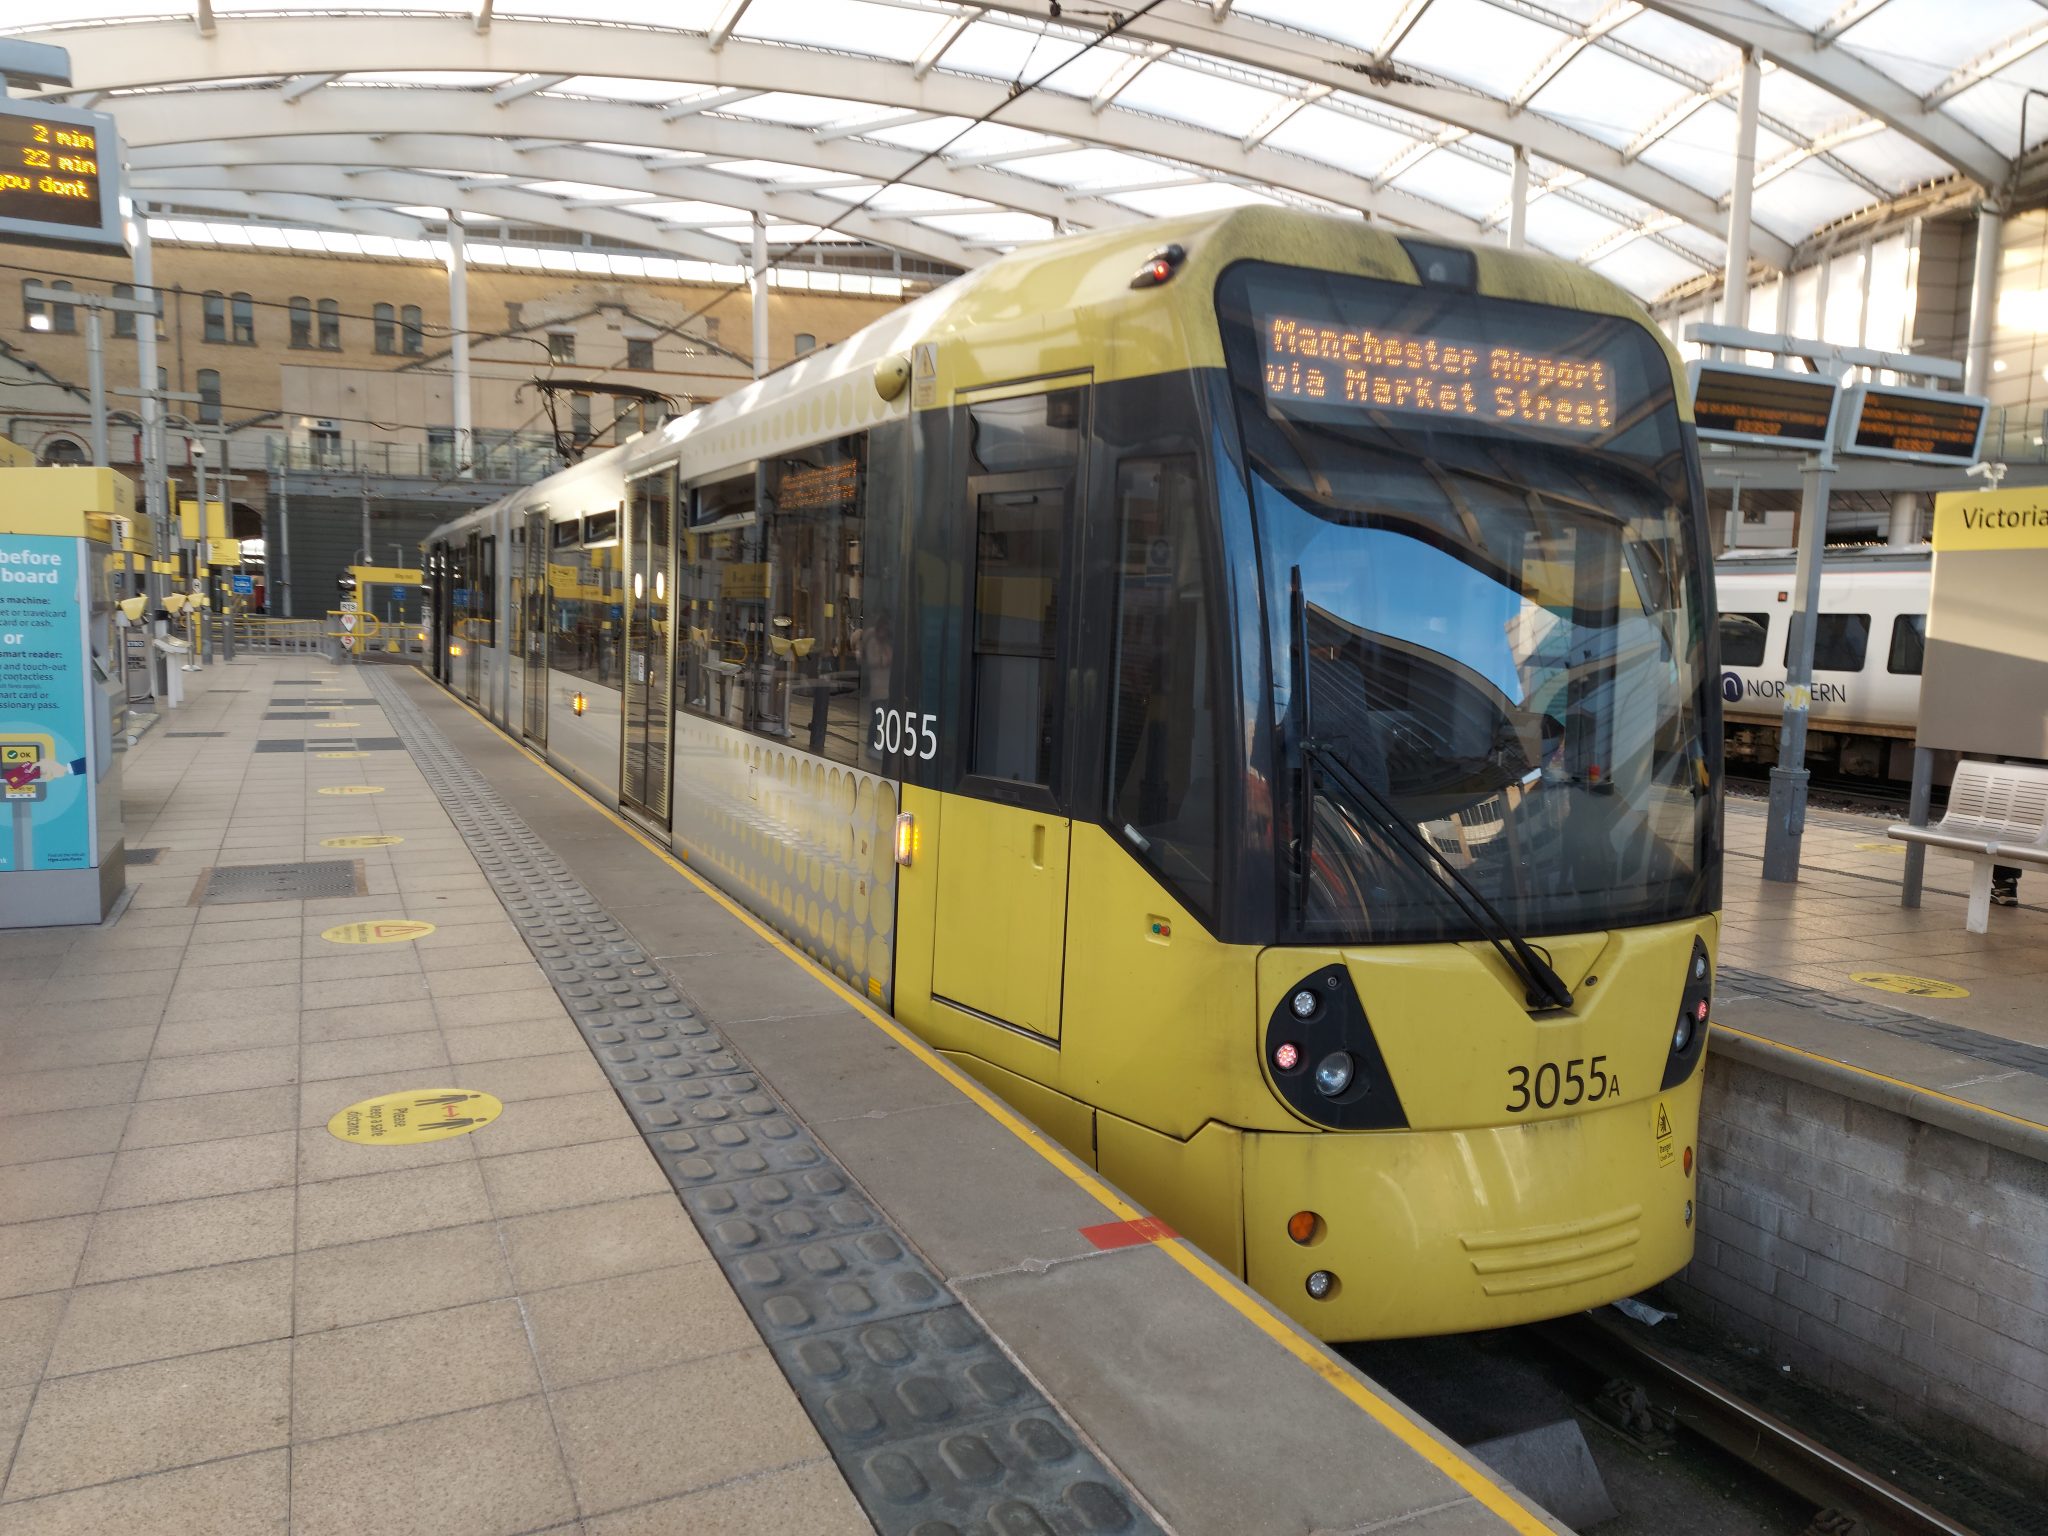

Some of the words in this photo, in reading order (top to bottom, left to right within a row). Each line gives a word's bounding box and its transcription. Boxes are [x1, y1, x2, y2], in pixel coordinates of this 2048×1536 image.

[32, 124, 49, 143] 2
[56, 130, 95, 149] min
[22, 148, 51, 168] 22
[58, 155, 97, 174] min
[39, 176, 88, 198] dont
[1273, 319, 1477, 375] Manchester
[1491, 349, 1606, 392] Airport
[1266, 362, 1326, 396] via
[1346, 368, 1477, 414] Market
[1495, 386, 1611, 428] Street
[1963, 504, 2048, 529] Victoria
[0, 549, 62, 566] before
[1, 568, 58, 584] board
[7, 596, 51, 605] machine:
[23, 609, 67, 618] travelcard
[4, 633, 25, 645] or
[28, 651, 63, 659] reader:
[3, 662, 20, 671] and
[22, 663, 67, 671] touch-out
[3, 673, 54, 681] contactless
[19, 691, 38, 699] card
[1747, 680, 1846, 703] NORERN
[38, 702, 60, 710] pass.
[873, 707, 937, 760] 3055
[347, 1111, 363, 1136] distance
[392, 1107, 409, 1128] Please
